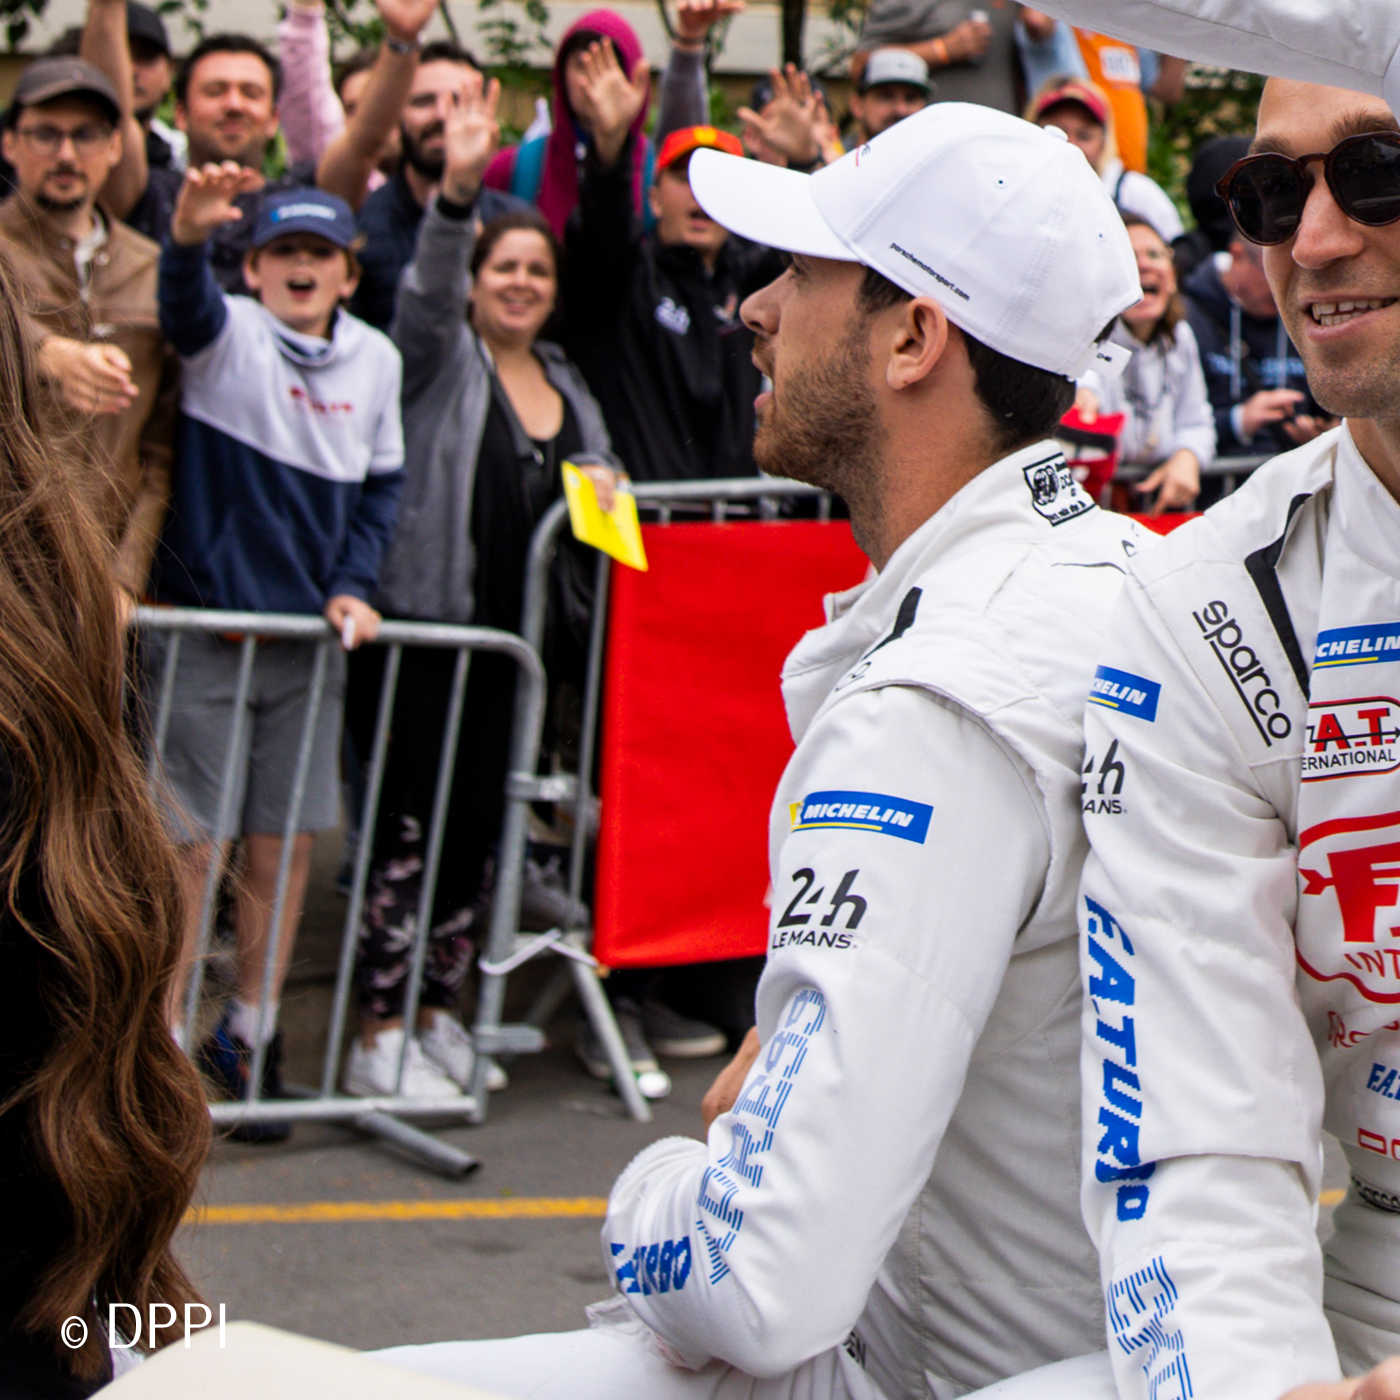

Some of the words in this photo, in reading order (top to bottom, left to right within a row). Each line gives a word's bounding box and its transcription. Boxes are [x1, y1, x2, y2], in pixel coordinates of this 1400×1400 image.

[1193, 600, 1292, 748] sparco
[803, 802, 915, 828] MICHELIN
[776, 867, 868, 930] 24h
